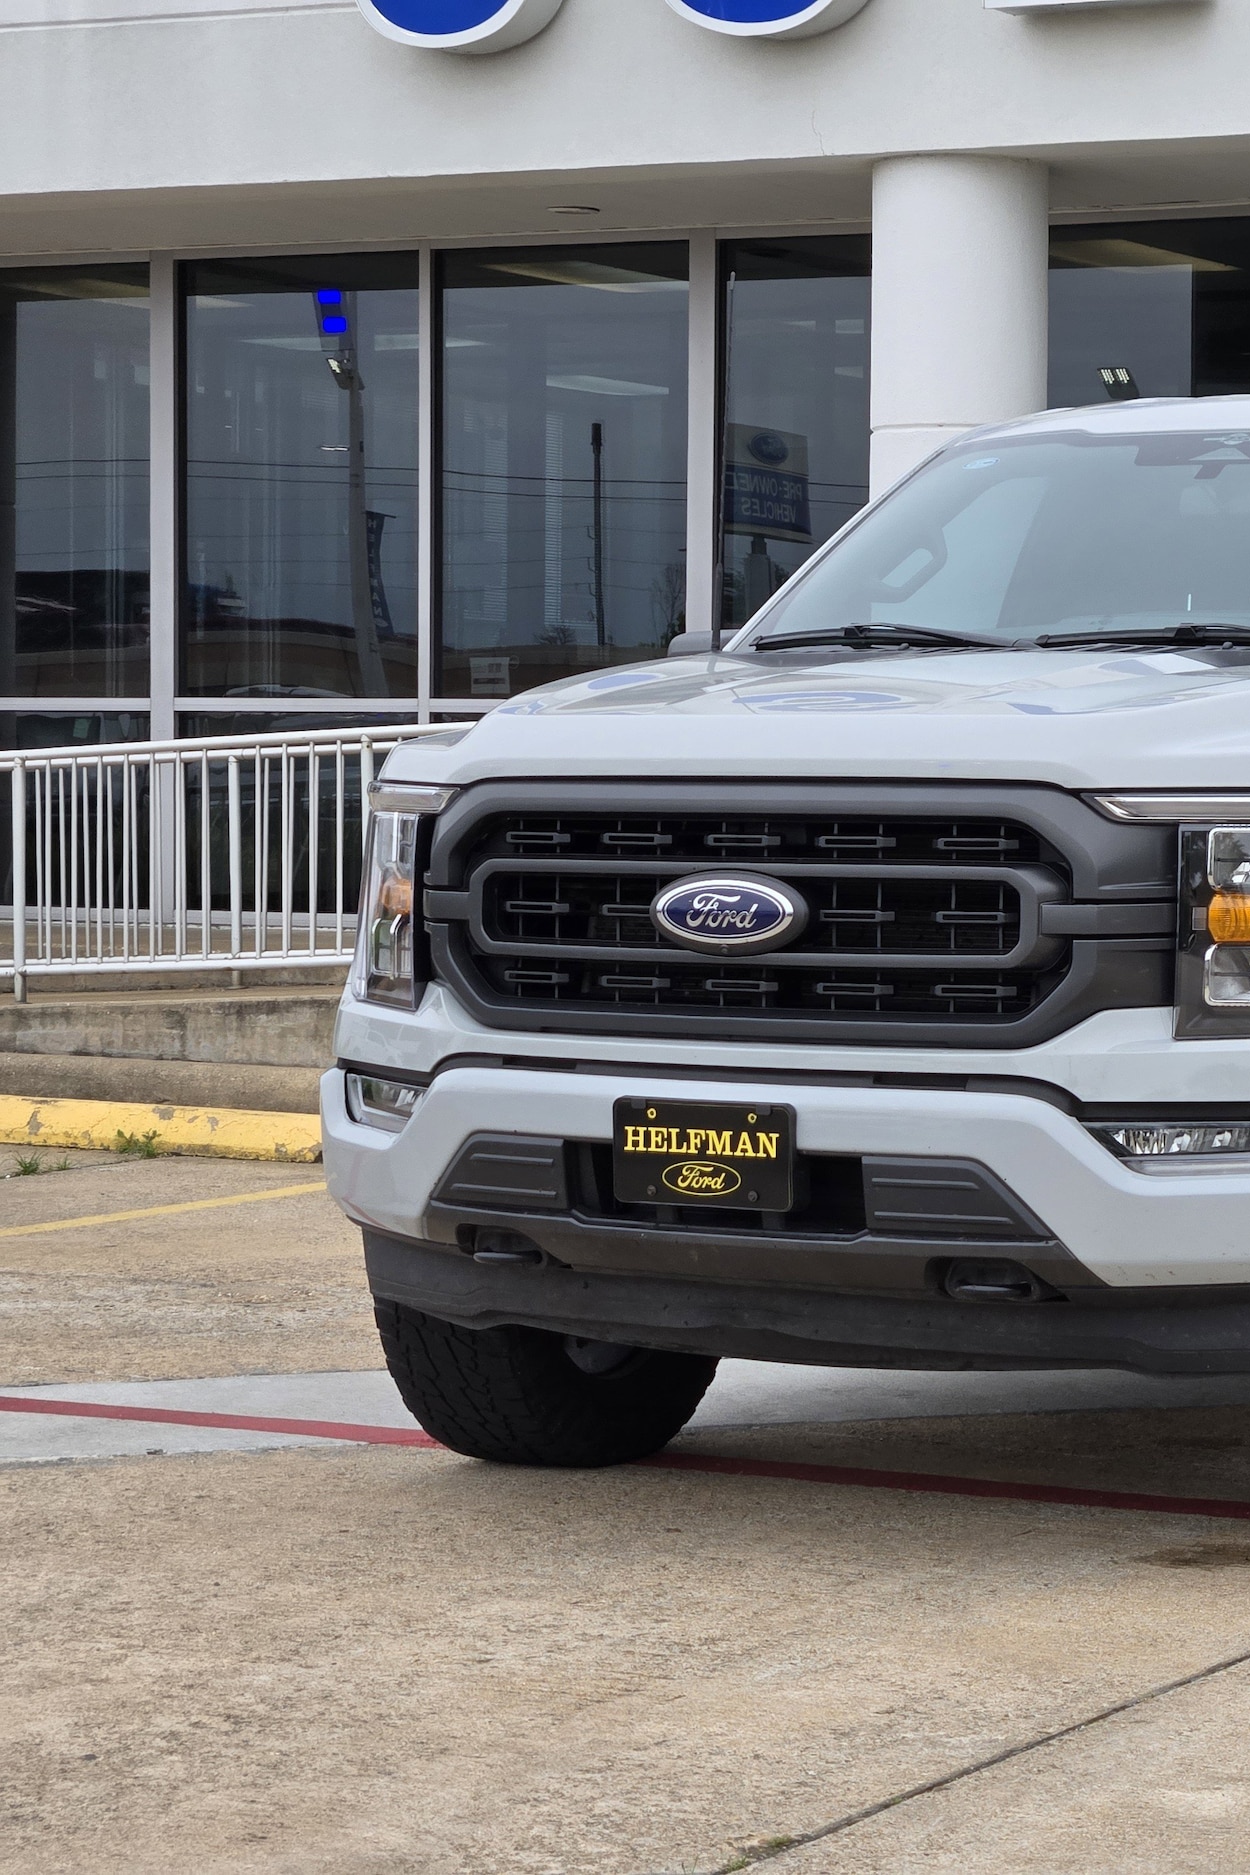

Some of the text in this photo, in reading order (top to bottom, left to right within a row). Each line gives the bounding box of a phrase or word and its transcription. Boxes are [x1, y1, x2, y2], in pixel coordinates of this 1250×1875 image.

[686, 893, 759, 929] Ford
[623, 1125, 780, 1159] HELFMAN
[677, 1164, 726, 1190] Ford
